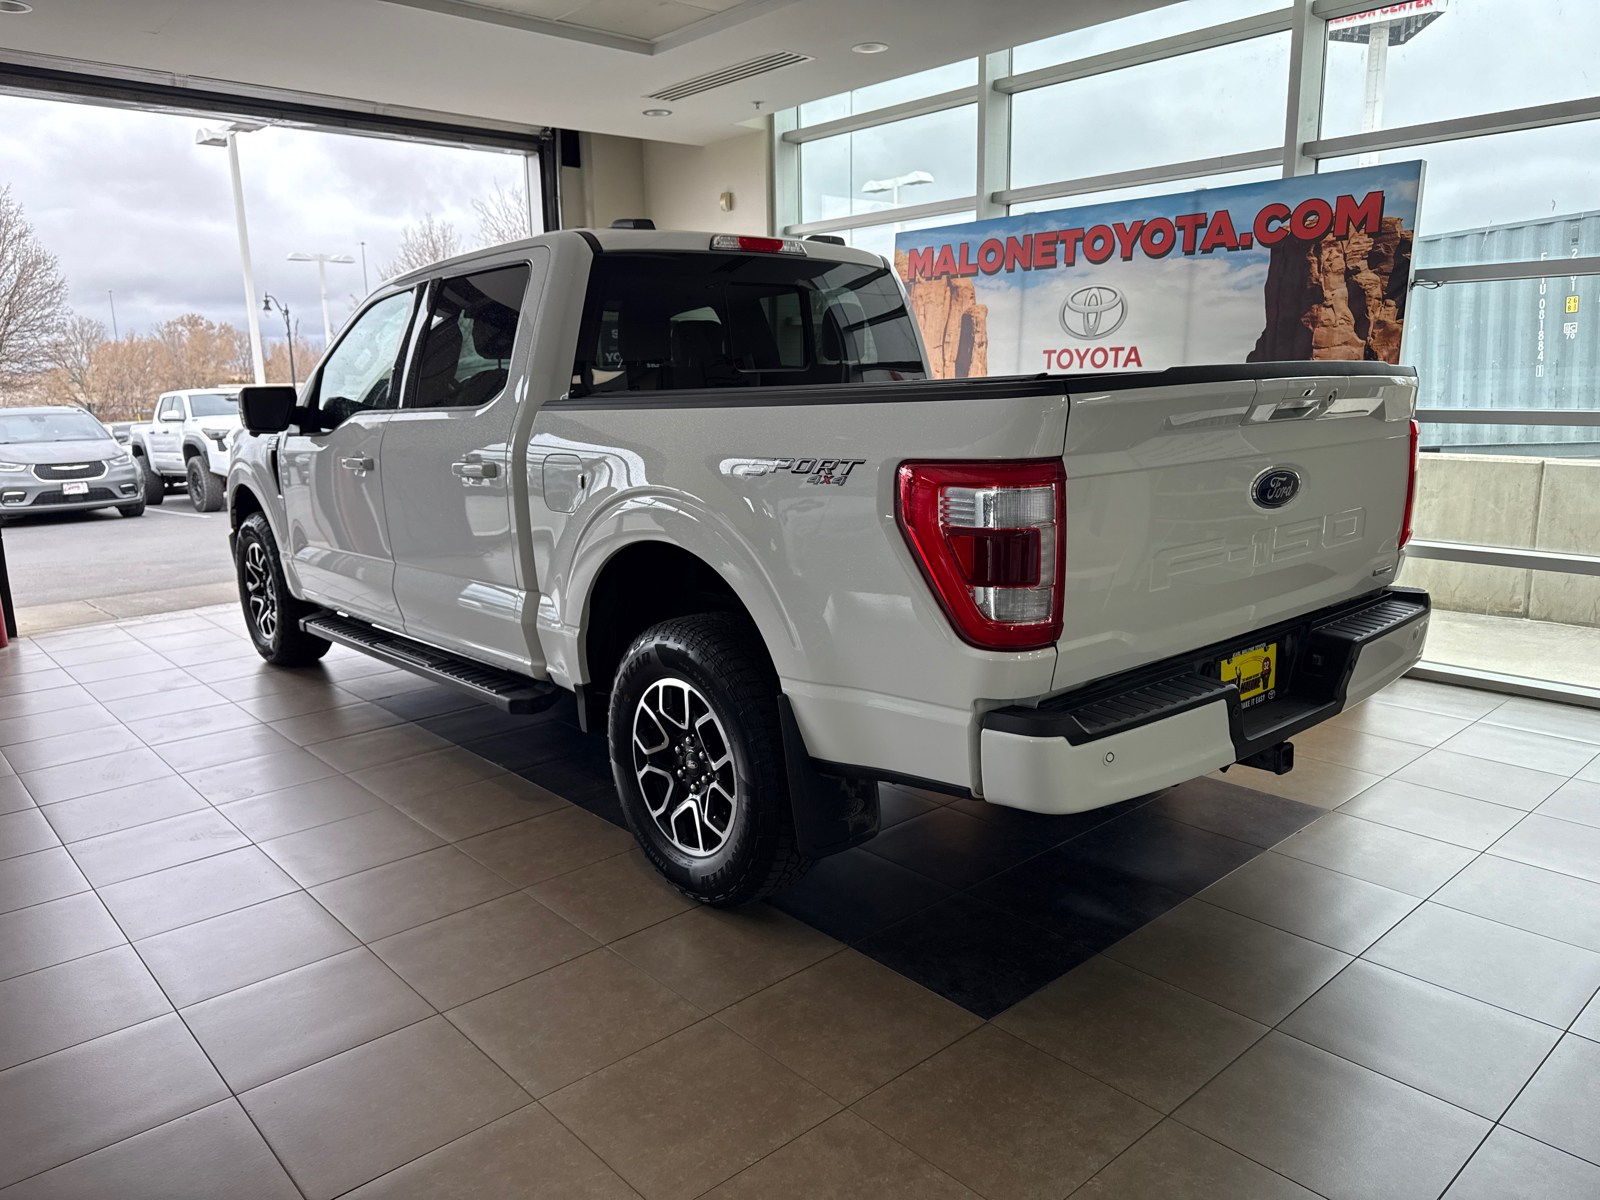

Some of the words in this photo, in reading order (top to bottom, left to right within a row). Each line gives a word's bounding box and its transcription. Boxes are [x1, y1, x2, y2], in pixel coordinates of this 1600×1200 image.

[907, 190, 1385, 282] MALONETOYOTA.COM
[1042, 346, 1142, 371] TOYOTA
[1266, 476, 1294, 500] Ford
